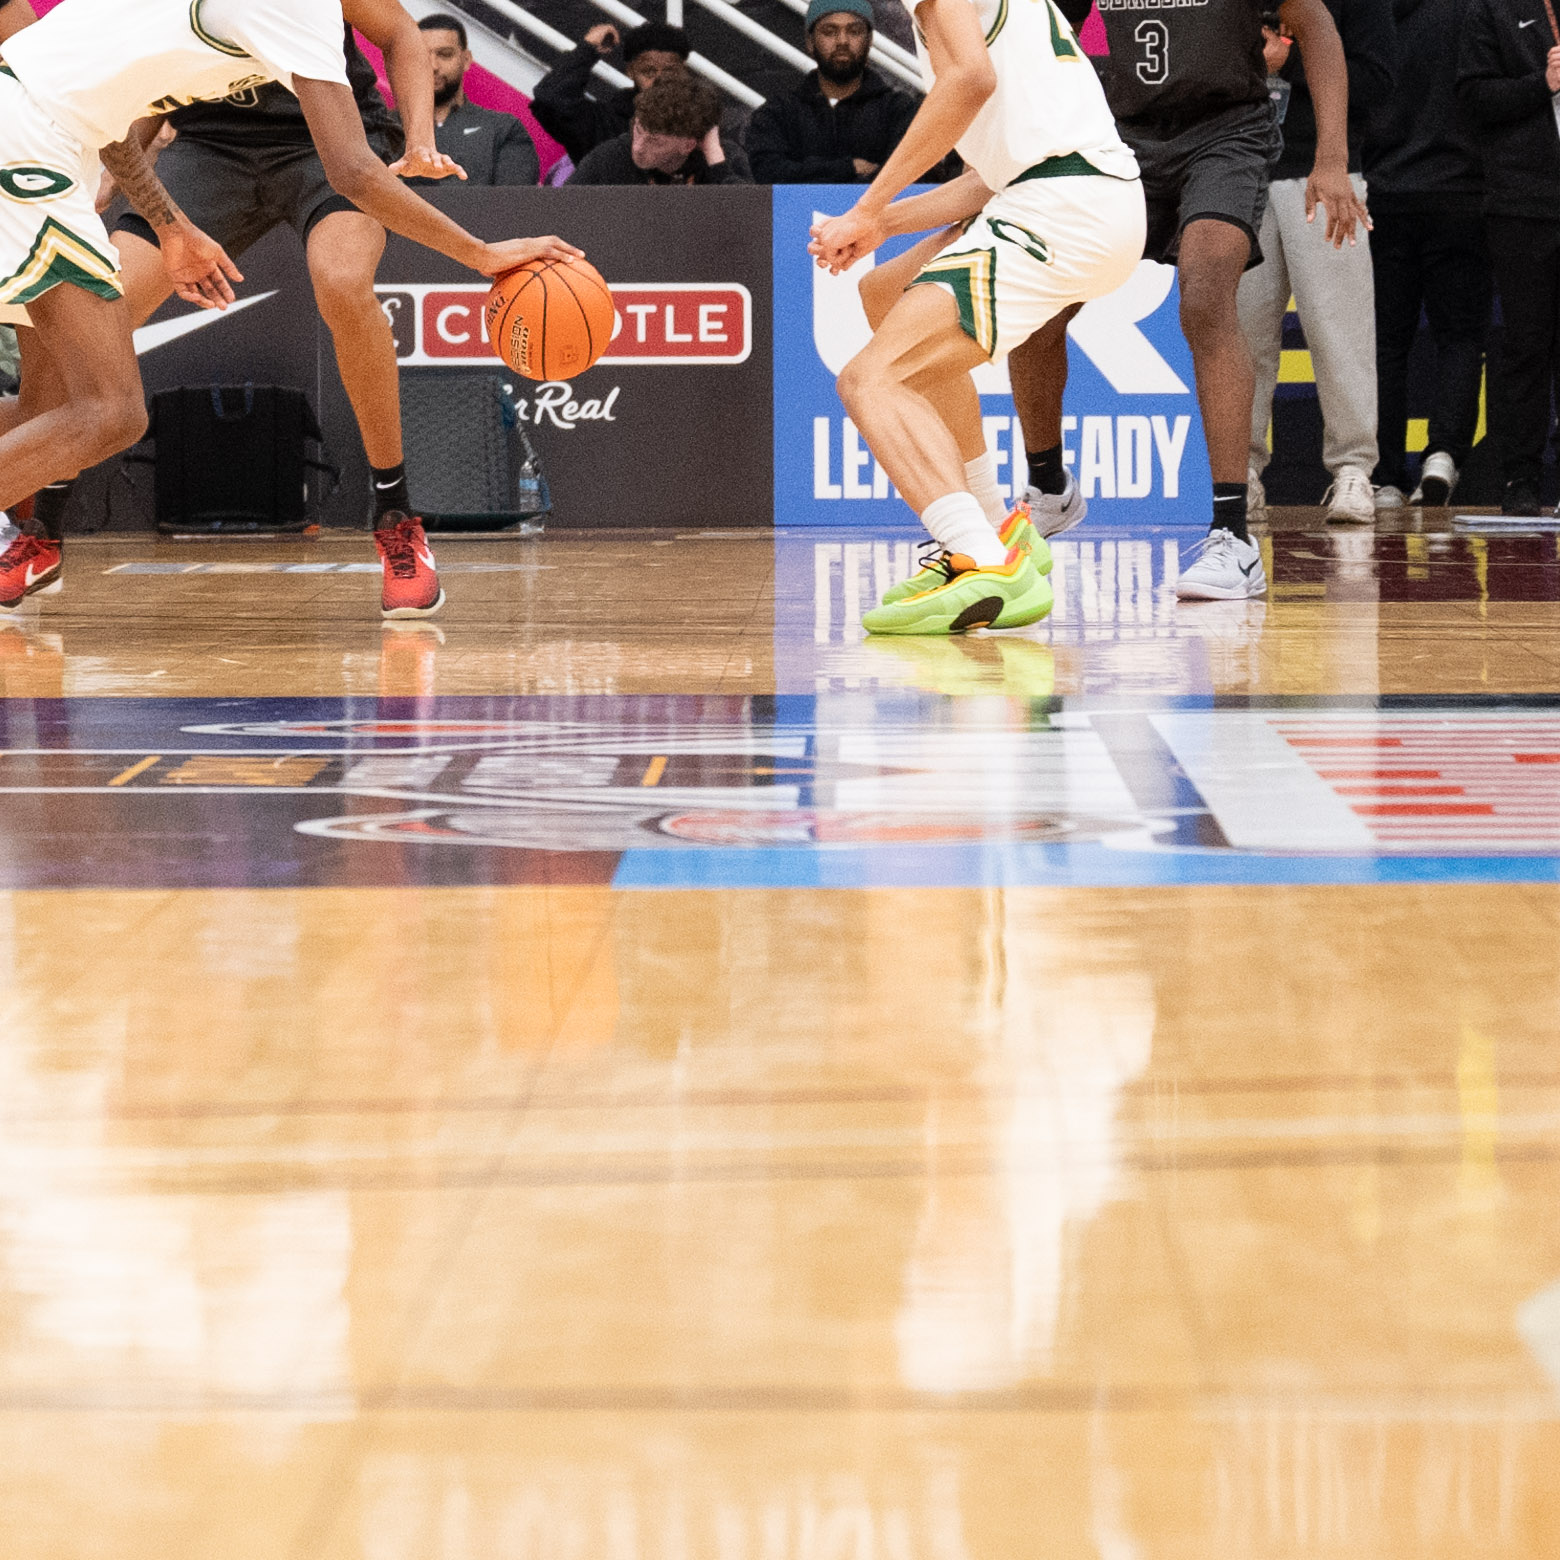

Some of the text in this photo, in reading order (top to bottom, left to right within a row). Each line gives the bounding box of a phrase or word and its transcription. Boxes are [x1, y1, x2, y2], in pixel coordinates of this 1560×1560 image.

[1135, 19, 1169, 84] 3
[436, 304, 729, 345] CTLE
[535, 382, 621, 429] Real
